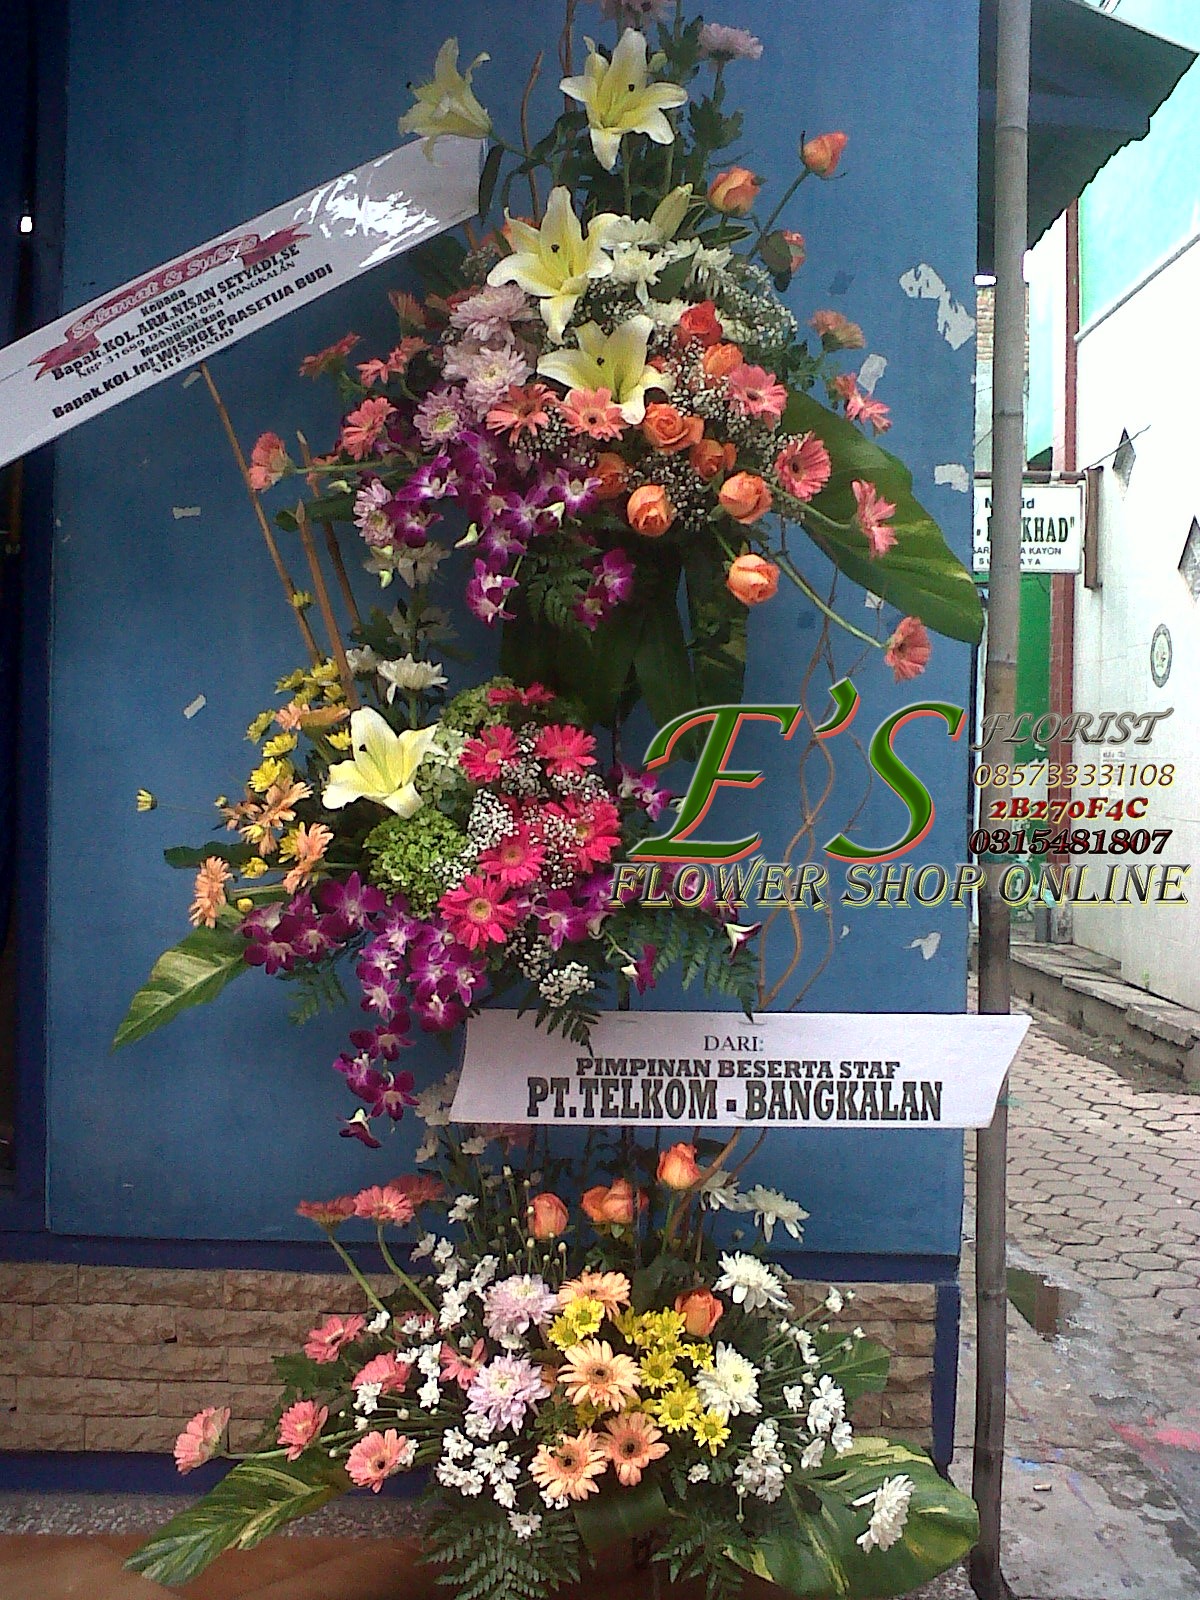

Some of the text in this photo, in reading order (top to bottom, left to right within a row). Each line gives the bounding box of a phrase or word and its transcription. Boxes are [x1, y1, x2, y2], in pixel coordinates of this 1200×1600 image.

[227, 260, 295, 300] BANGKALAN
[295, 263, 333, 290] BUDI
[72, 282, 159, 338] Selamat
[163, 270, 183, 288] &
[140, 289, 186, 317] Kepada
[1029, 547, 1061, 555] KAYON
[704, 1036, 764, 1051] DARI:
[576, 1057, 900, 1079] PIMPINAN BESERTA STAF
[527, 1077, 717, 1119] PT.TELKOM
[745, 1080, 942, 1120] BANGKALAN
